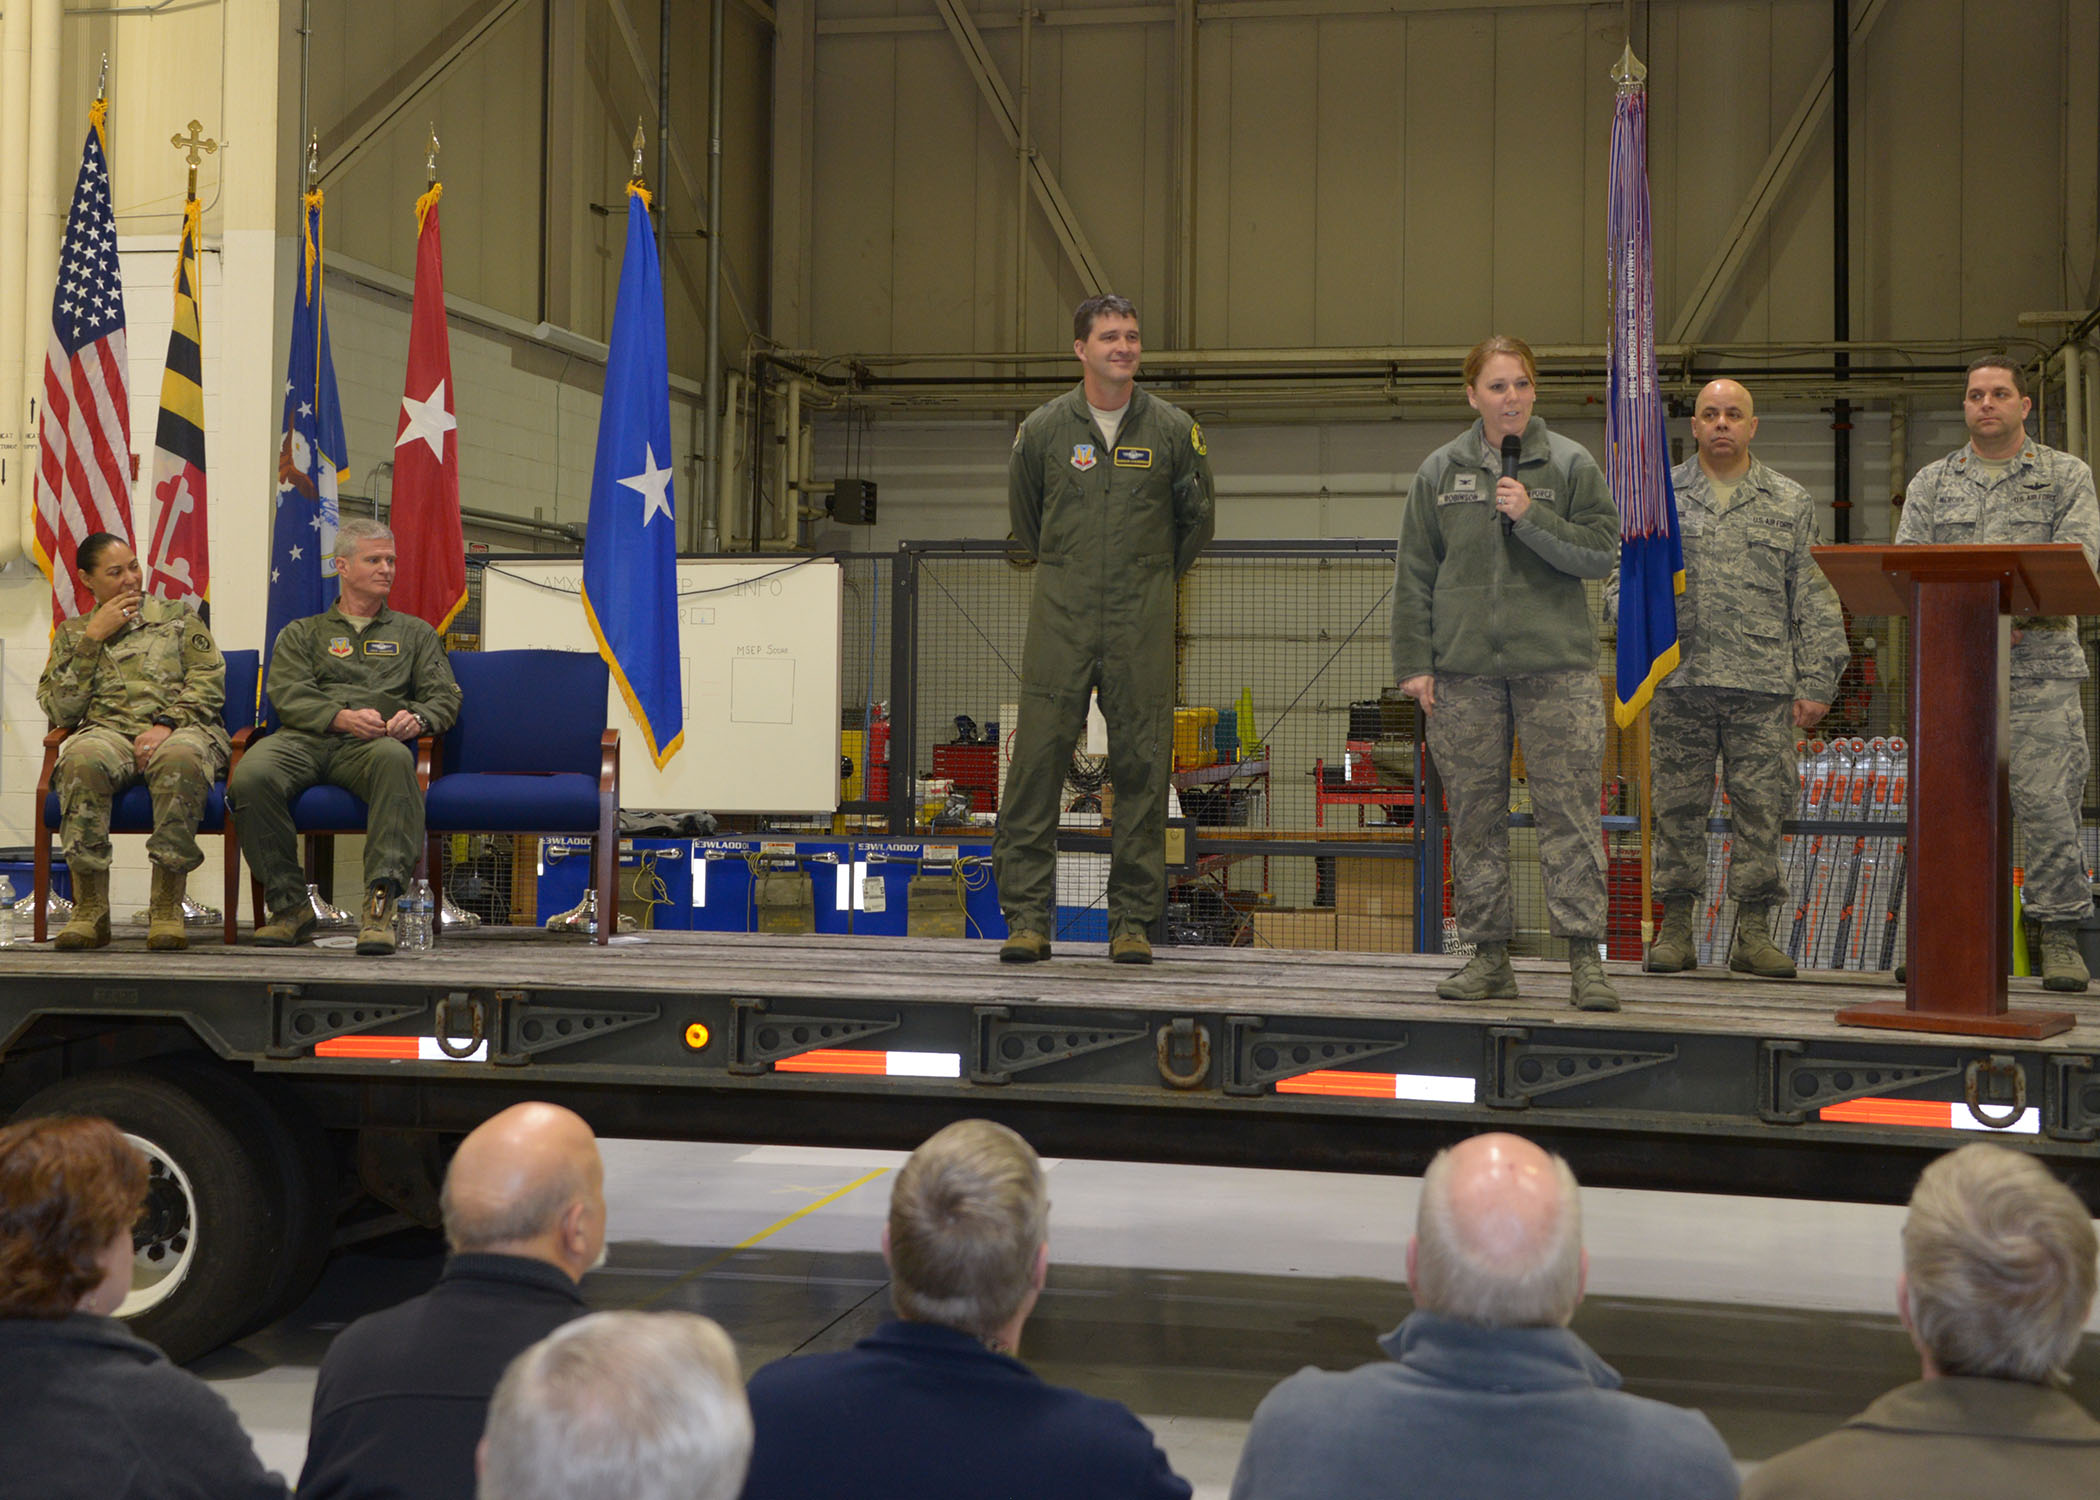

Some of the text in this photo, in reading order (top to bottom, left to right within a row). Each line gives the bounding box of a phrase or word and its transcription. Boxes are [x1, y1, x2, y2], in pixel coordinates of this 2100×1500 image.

[1627, 250, 1635, 288] JANUARY
[1628, 329, 1637, 377] DECEMBER
[1444, 494, 1478, 502] ROBINSON
[1531, 489, 1553, 498] FORCE
[733, 577, 783, 597] INFO
[736, 645, 761, 656] MSEP
